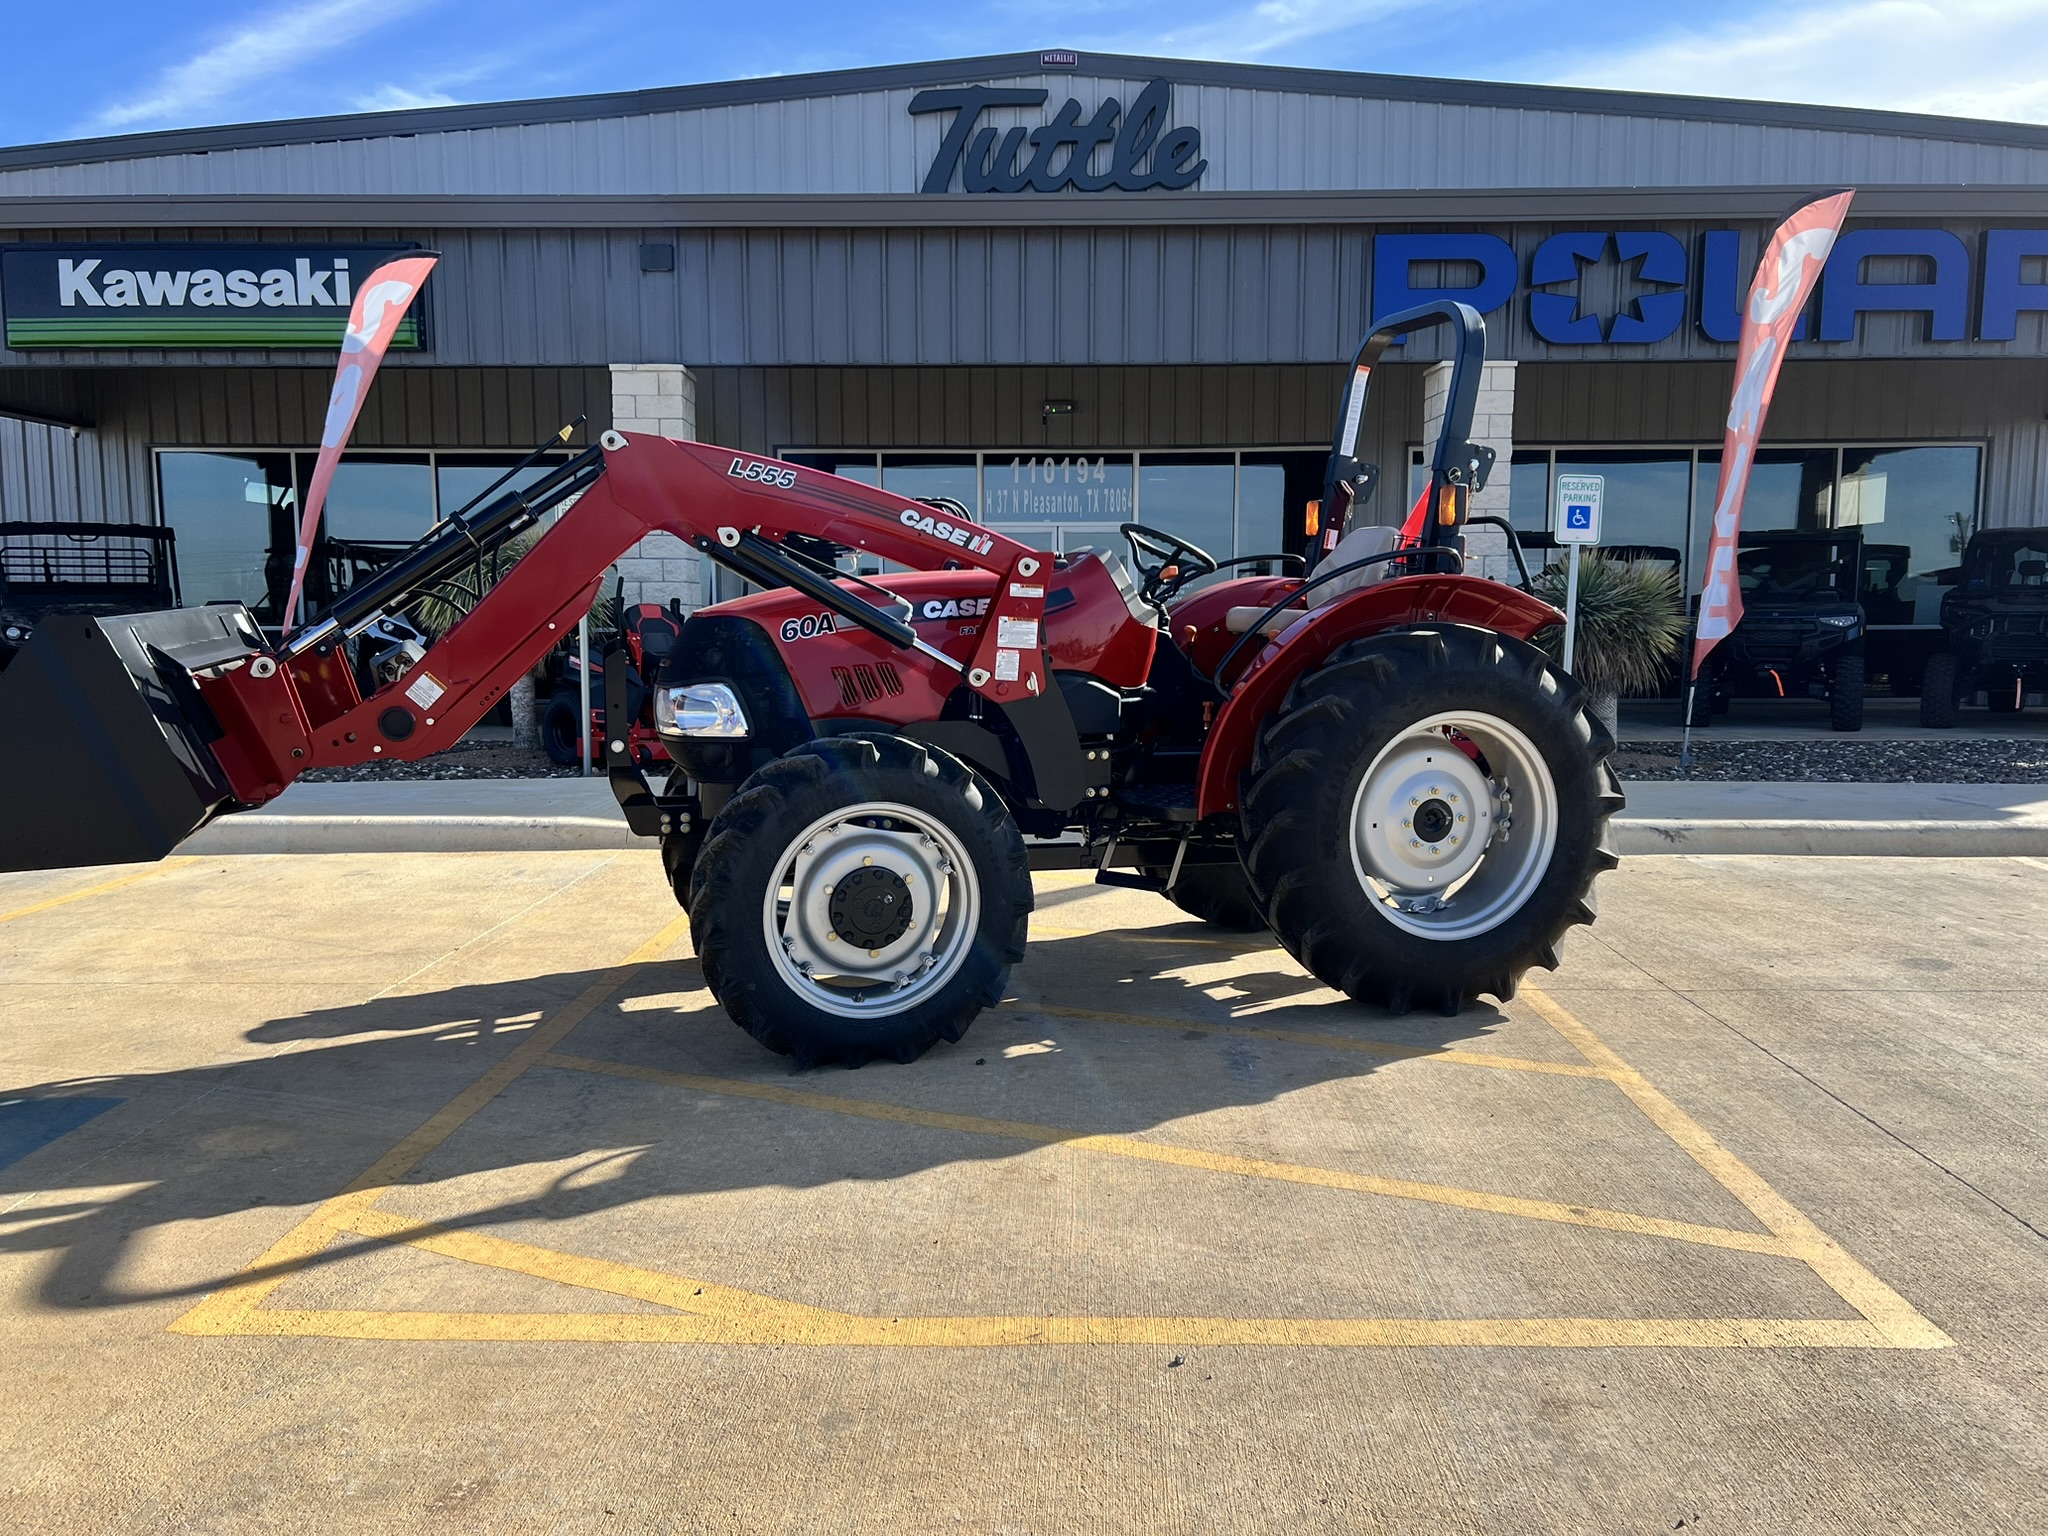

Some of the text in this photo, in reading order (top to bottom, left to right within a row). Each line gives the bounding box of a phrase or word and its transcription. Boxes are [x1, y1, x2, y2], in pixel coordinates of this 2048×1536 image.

[1044, 53, 1075, 63] METALLIC
[907, 78, 1208, 193] Tuttle
[58, 257, 351, 308] Kawasaki
[728, 458, 797, 489] L555
[1010, 457, 1106, 484] 110194
[1562, 482, 1600, 491] RESERVED
[1563, 493, 1597, 503] PARKING
[997, 489, 1008, 514] 37
[1013, 489, 1019, 514] N
[1023, 488, 1083, 518] Pleasanton,
[1087, 488, 1100, 513] TX
[900, 509, 971, 547] CASE
[780, 612, 837, 643] 60A
